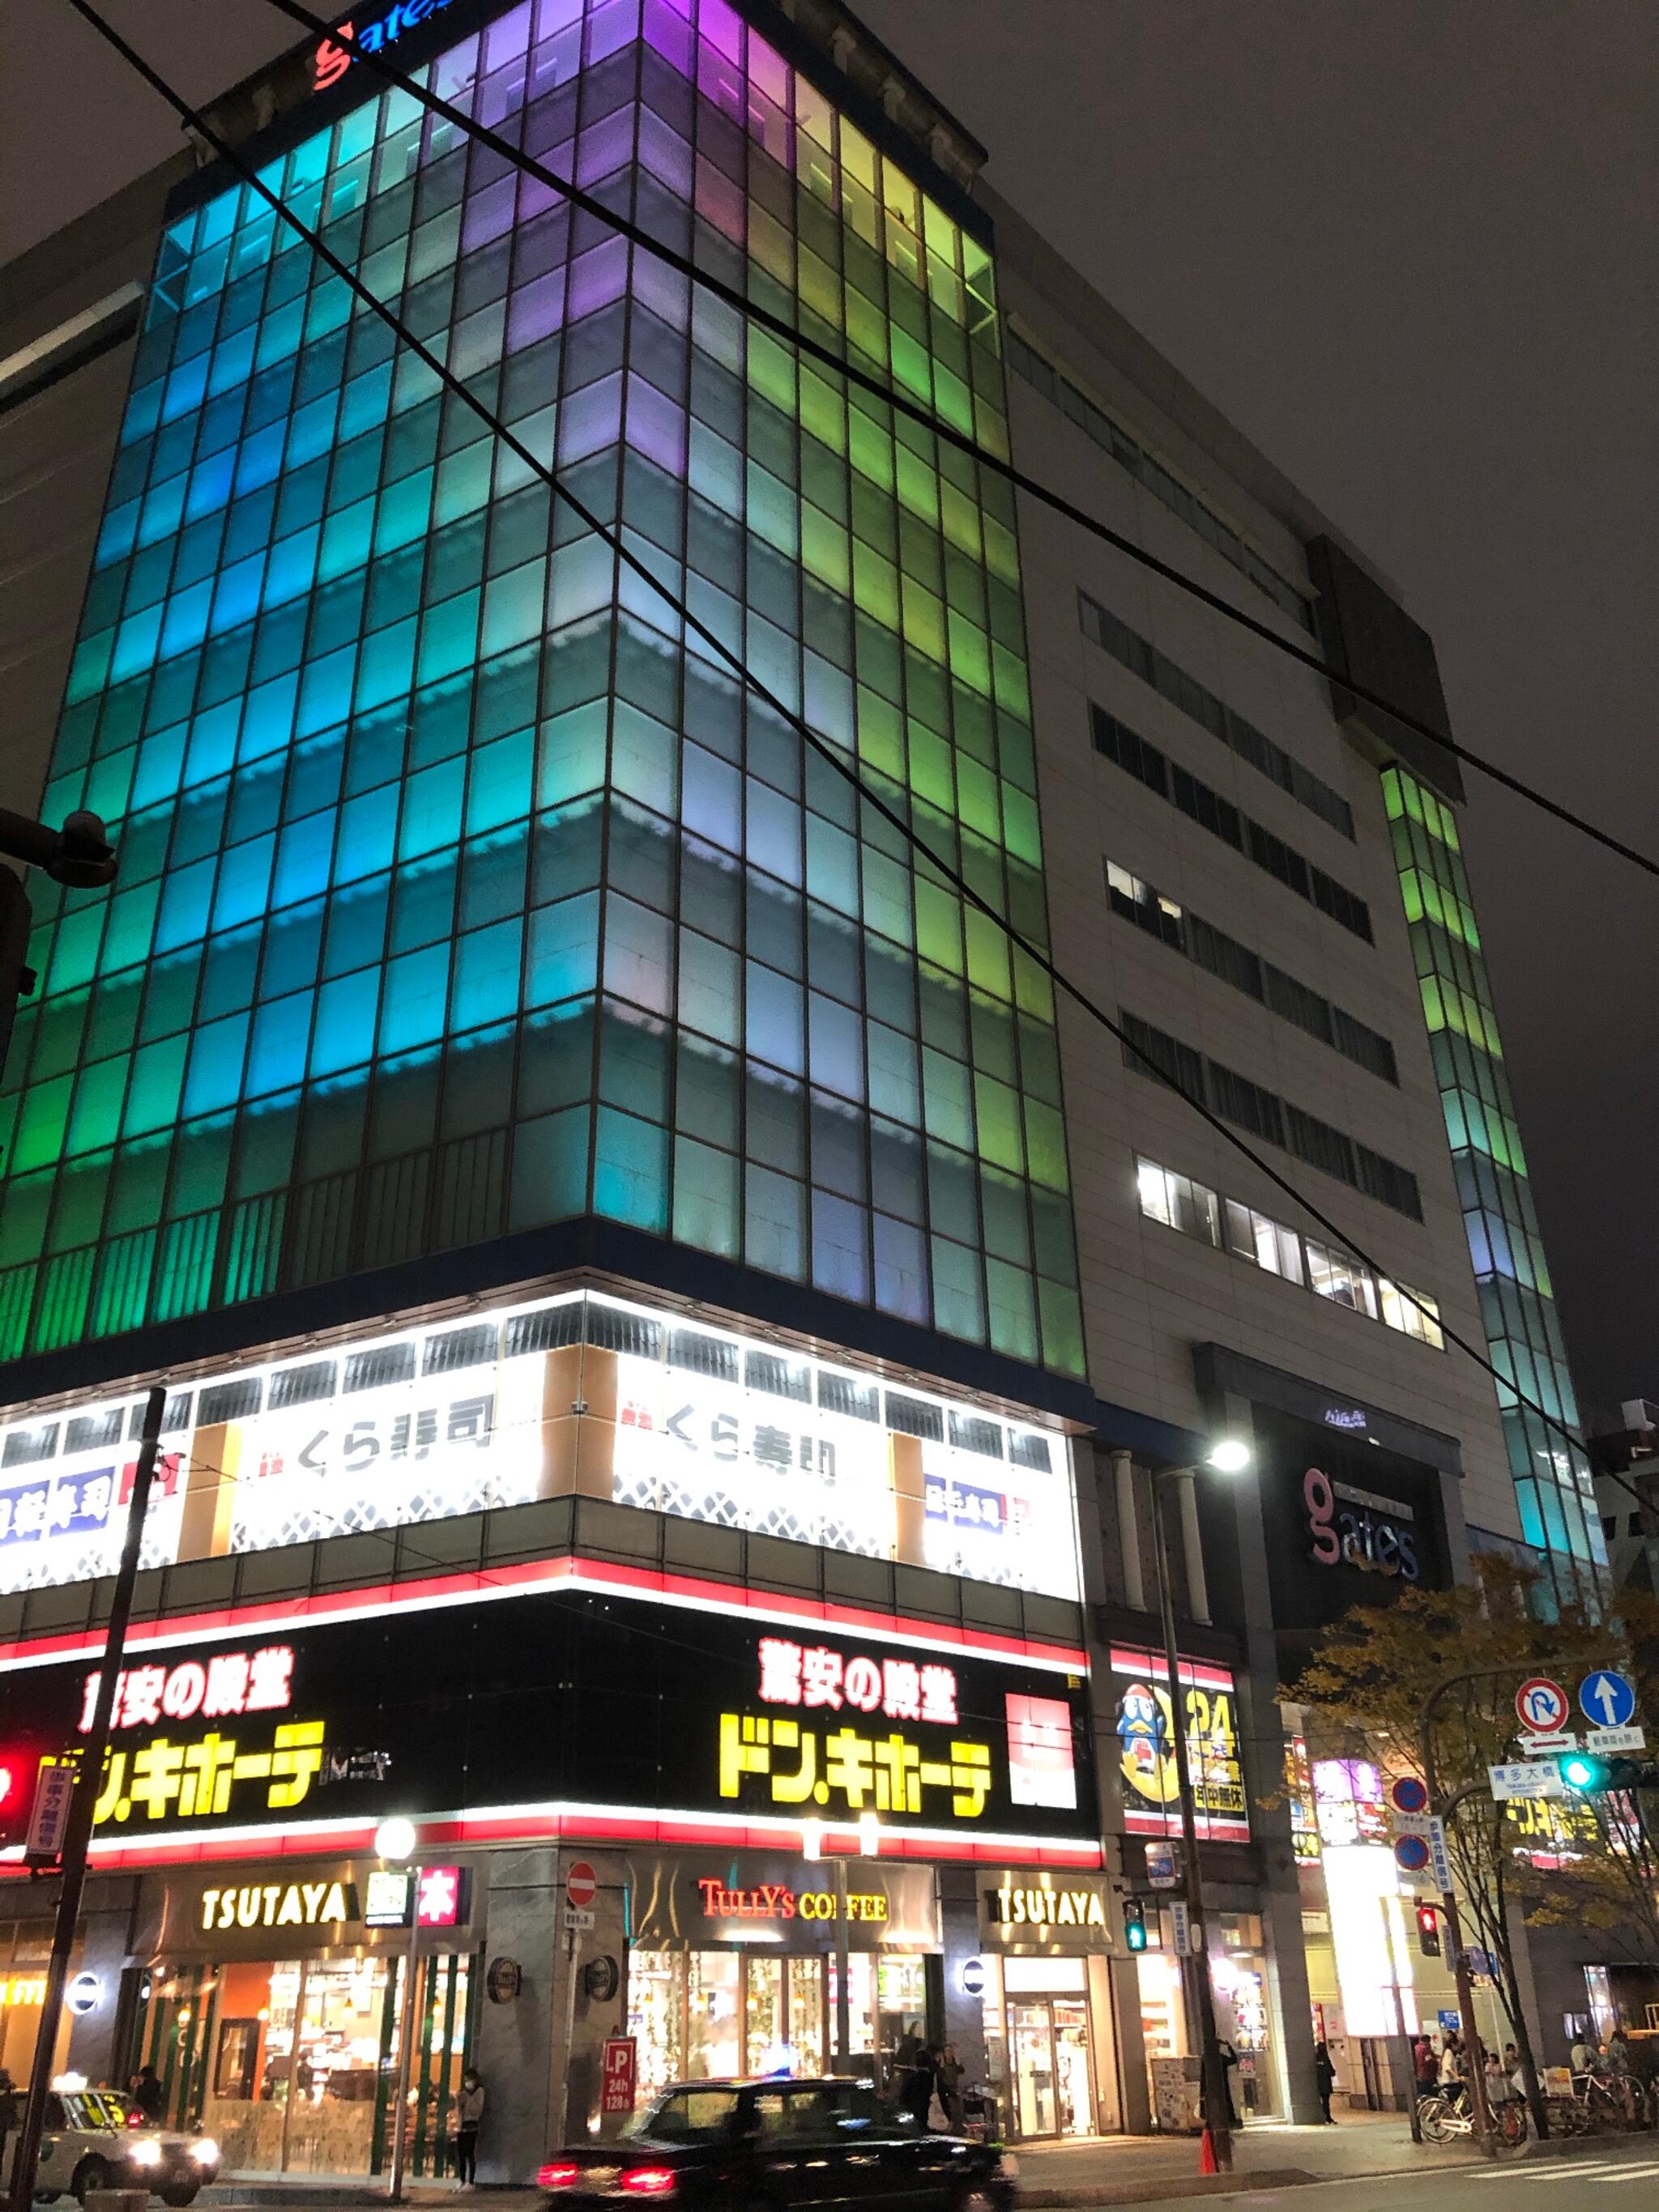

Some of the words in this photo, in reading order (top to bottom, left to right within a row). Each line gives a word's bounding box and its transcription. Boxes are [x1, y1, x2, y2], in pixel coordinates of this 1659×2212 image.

[759, 1638, 958, 1724] 驚安の殿堂
[1493, 1765, 1555, 1782] 博多大橋
[1196, 1785, 1243, 1809] 年中無休
[1429, 1821, 1448, 1889] 歩車分離信号
[202, 1882, 346, 1929] TSUTAYA
[419, 1870, 454, 1922] 本
[997, 1888, 1105, 1925] TSUTAYA
[616, 2050, 628, 2073] P
[608, 2078, 629, 2093] 24h
